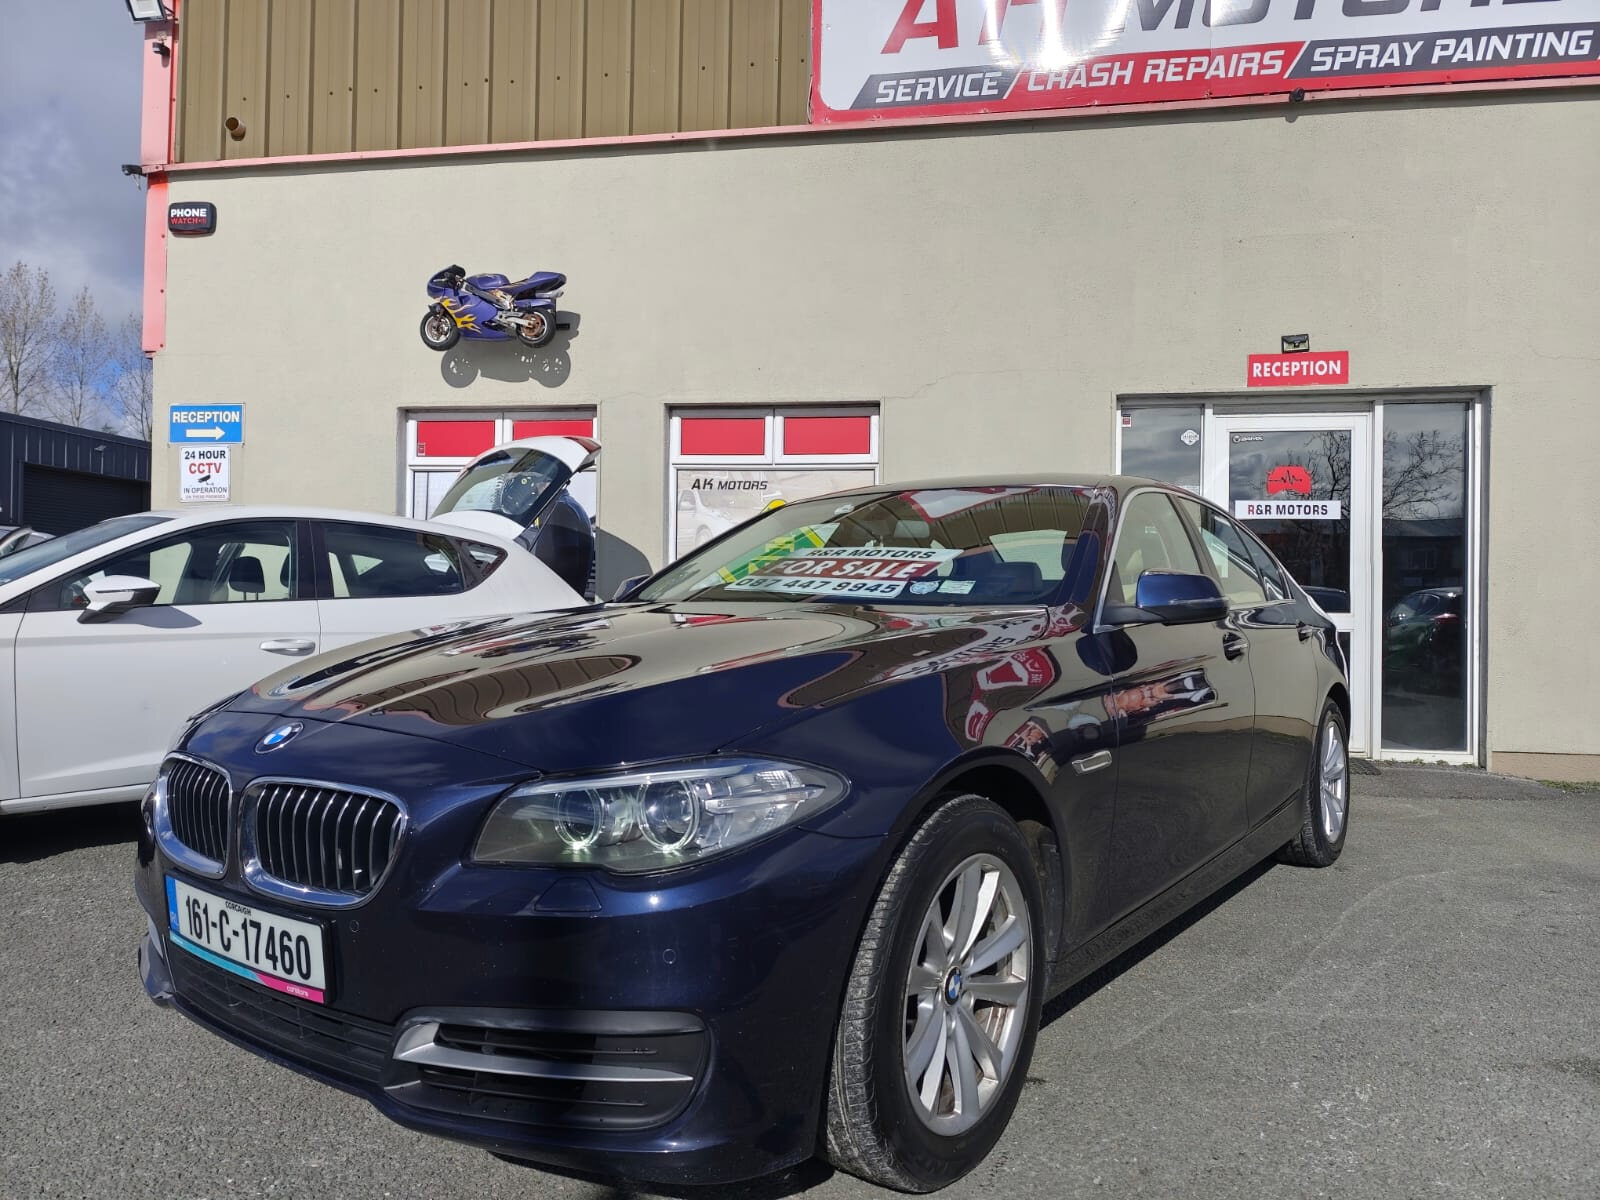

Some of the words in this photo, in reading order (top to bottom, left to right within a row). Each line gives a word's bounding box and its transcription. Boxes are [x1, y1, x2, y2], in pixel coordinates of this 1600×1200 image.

[875, 71, 1002, 103] SERVICE
[1027, 58, 1134, 92] CRASH
[1145, 49, 1285, 84] REPAIRS
[1311, 40, 1424, 72] SPRAY
[1431, 29, 1594, 65] PAINTING
[170, 208, 208, 218] PHONE
[170, 217, 198, 225] WATCH
[1252, 359, 1341, 378] RECEPTION
[172, 411, 240, 424] RECEPTION
[184, 450, 196, 460] 24
[198, 450, 226, 460] HOUR
[188, 462, 222, 474] CCTV
[191, 486, 228, 494] OPERATION
[690, 478, 714, 490] AK
[717, 480, 768, 490] MOTORS
[1247, 504, 1272, 516] R&R
[1276, 504, 1328, 516] MOTORS
[806, 549, 843, 558] R&R
[848, 549, 937, 560] MOTORS
[765, 560, 830, 577] FOR
[832, 560, 925, 579] SALE
[735, 578, 779, 588] 087
[783, 579, 826, 590] 447
[835, 581, 901, 595] 9945
[186, 895, 311, 981] 161-C-17460
